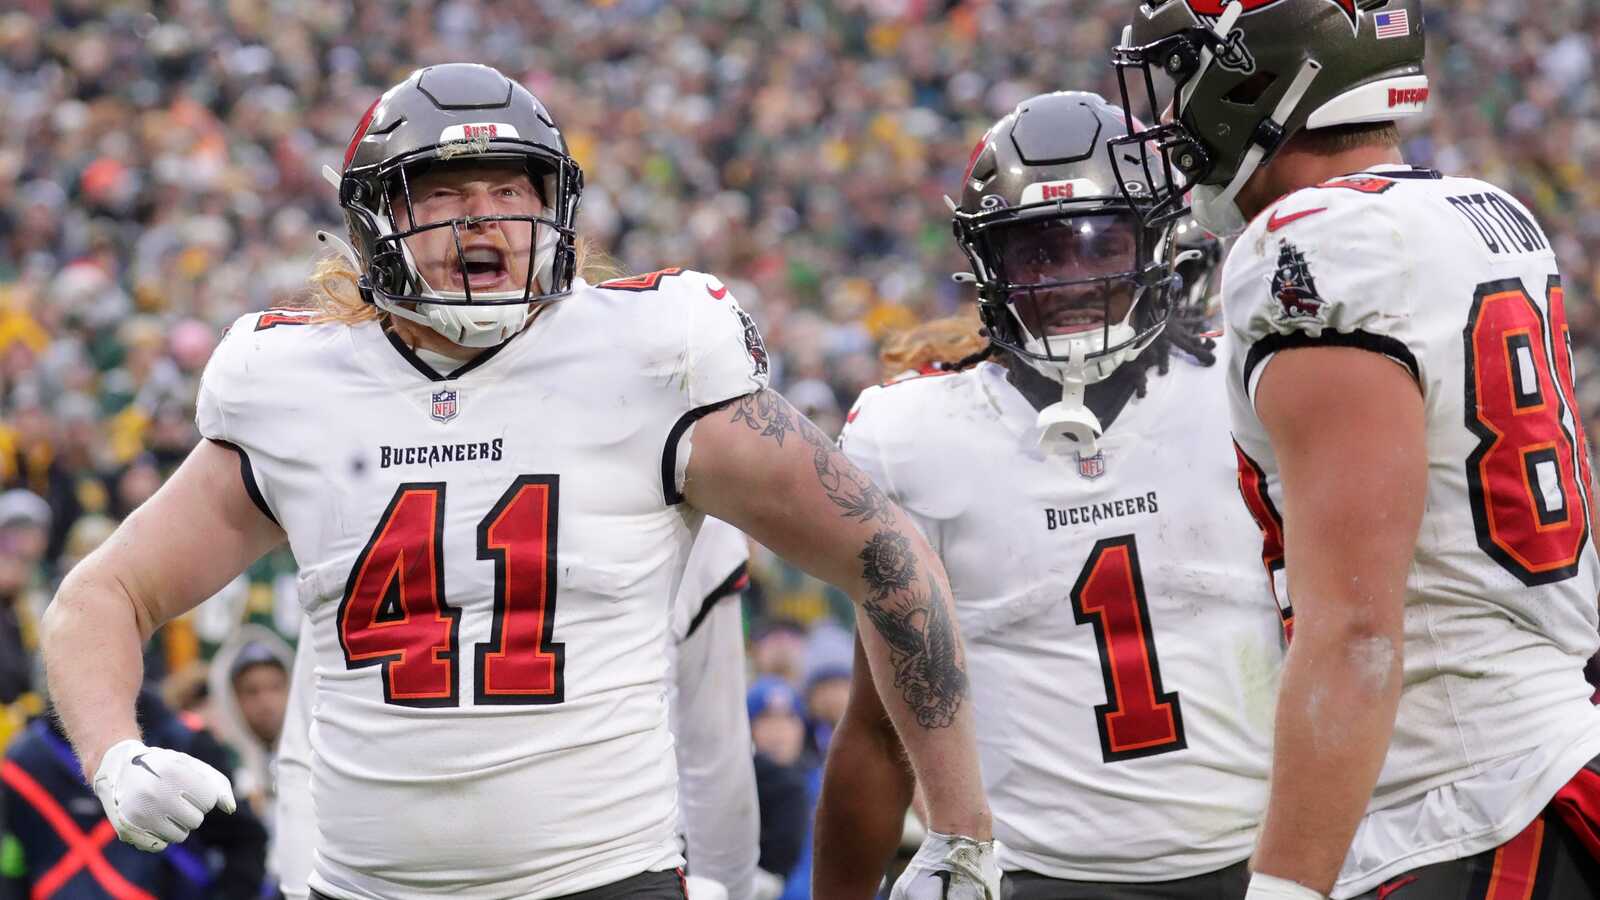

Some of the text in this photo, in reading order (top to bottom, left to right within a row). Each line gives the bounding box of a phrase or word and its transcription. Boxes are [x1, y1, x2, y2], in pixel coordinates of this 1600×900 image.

[1042, 183, 1073, 200] BUCS
[434, 401, 456, 416] NFL
[379, 438, 503, 469] BUCCANEERS
[1045, 491, 1159, 530] BUCCANEERS
[336, 474, 565, 707] 41
[1069, 533, 1188, 763] 1
